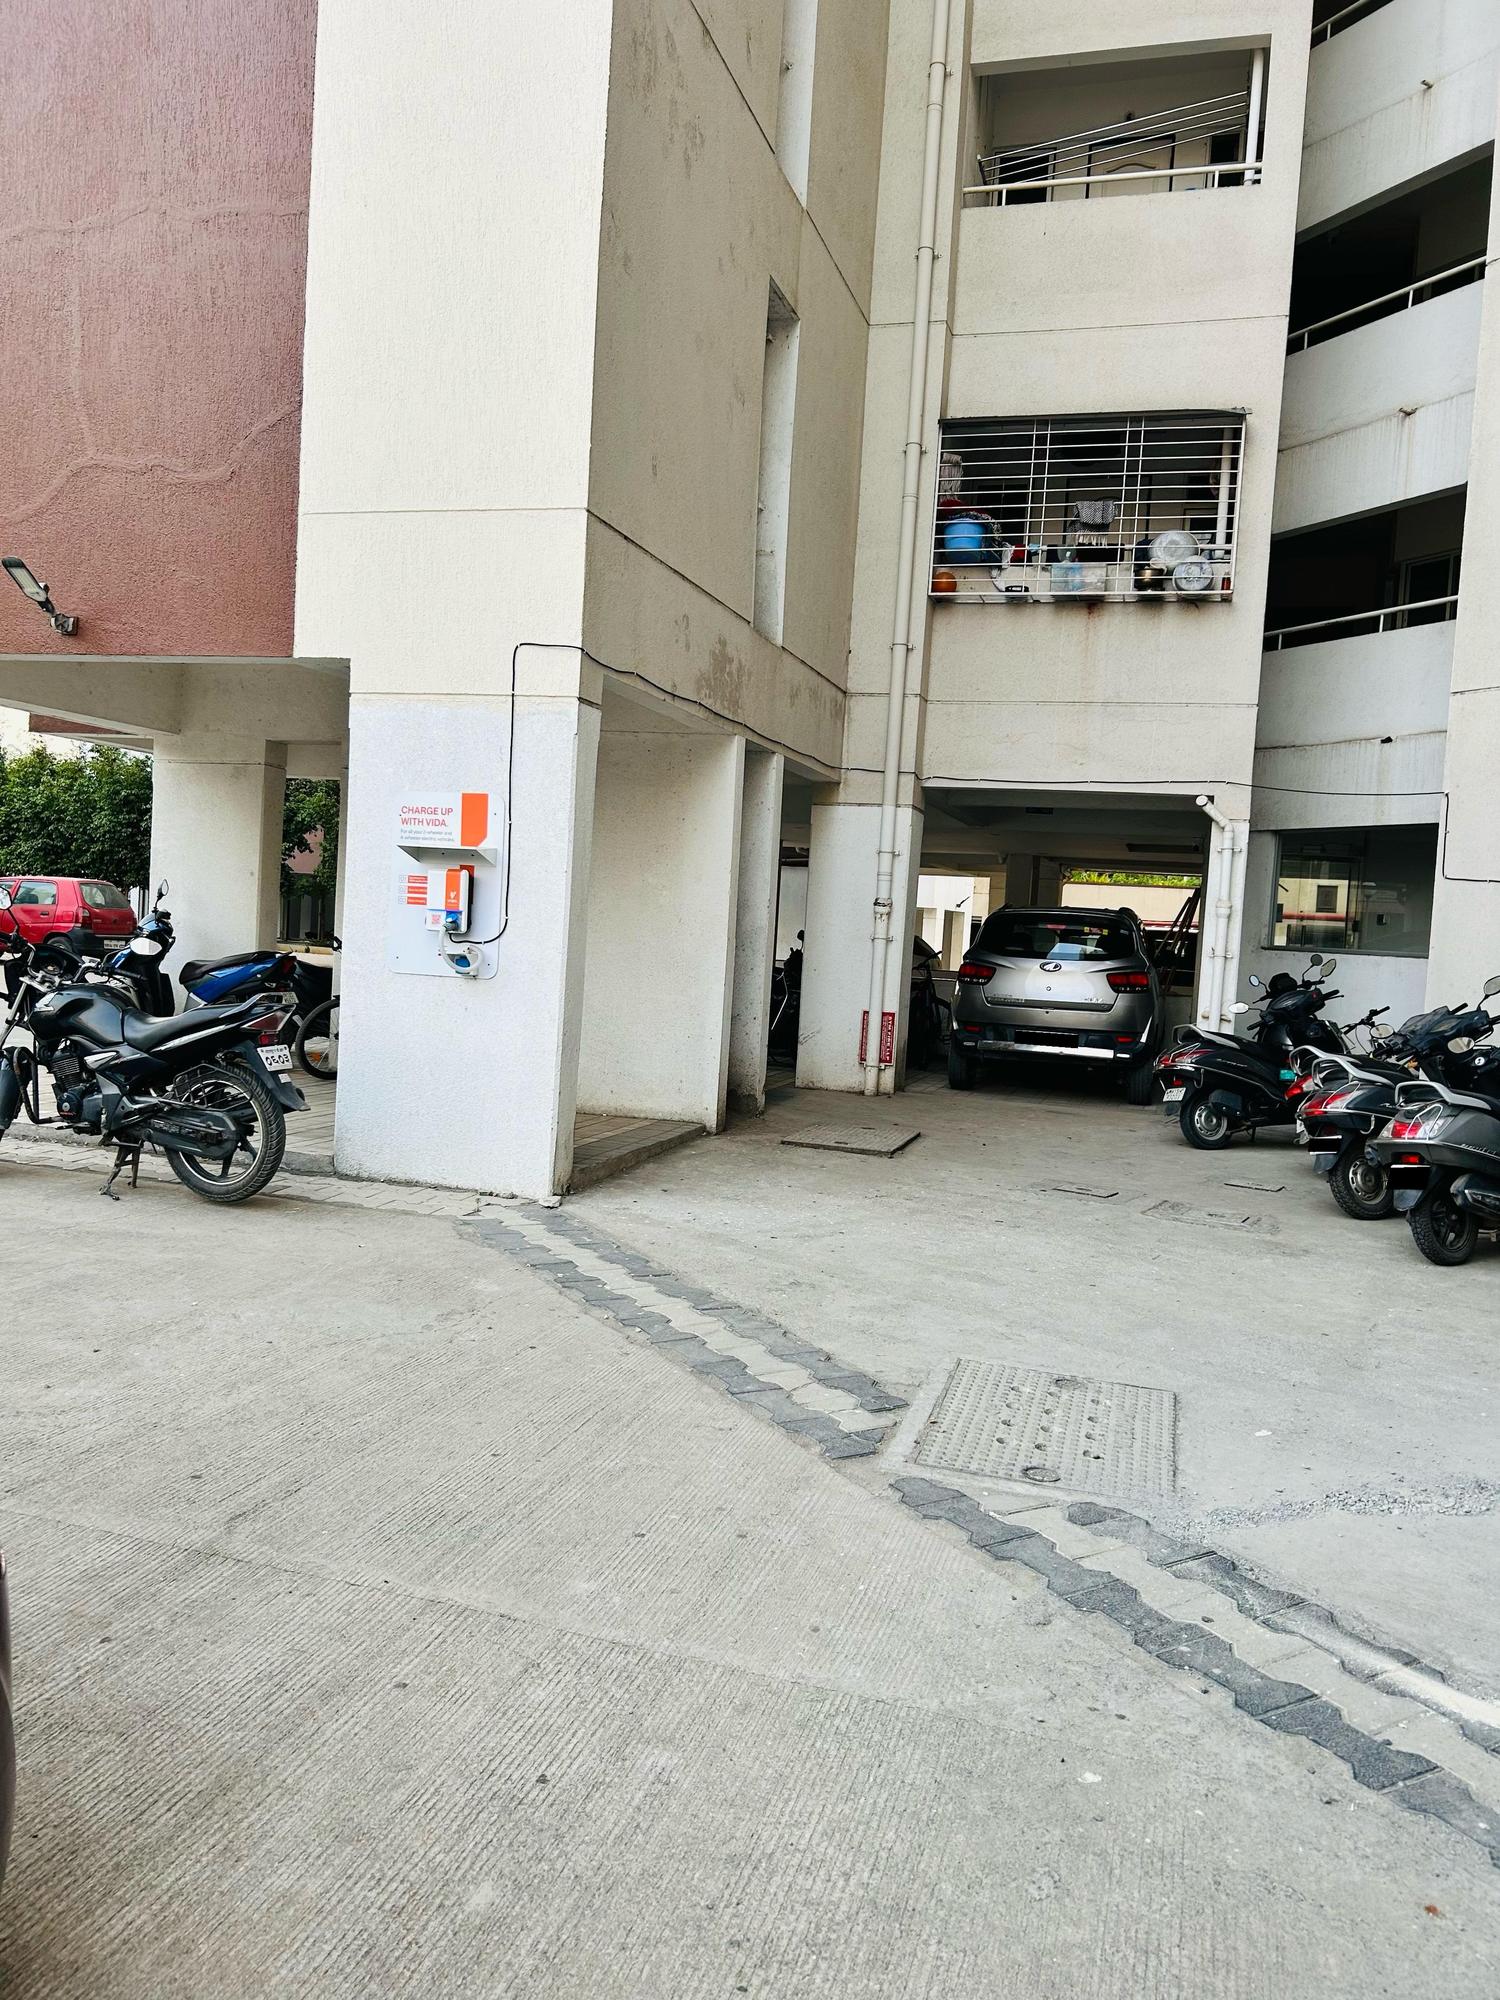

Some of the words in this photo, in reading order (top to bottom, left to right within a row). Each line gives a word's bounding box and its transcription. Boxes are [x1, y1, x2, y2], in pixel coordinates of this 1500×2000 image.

[401, 806, 439, 815] CHARGE
[441, 807, 453, 816] UP
[401, 817, 424, 826] WITH
